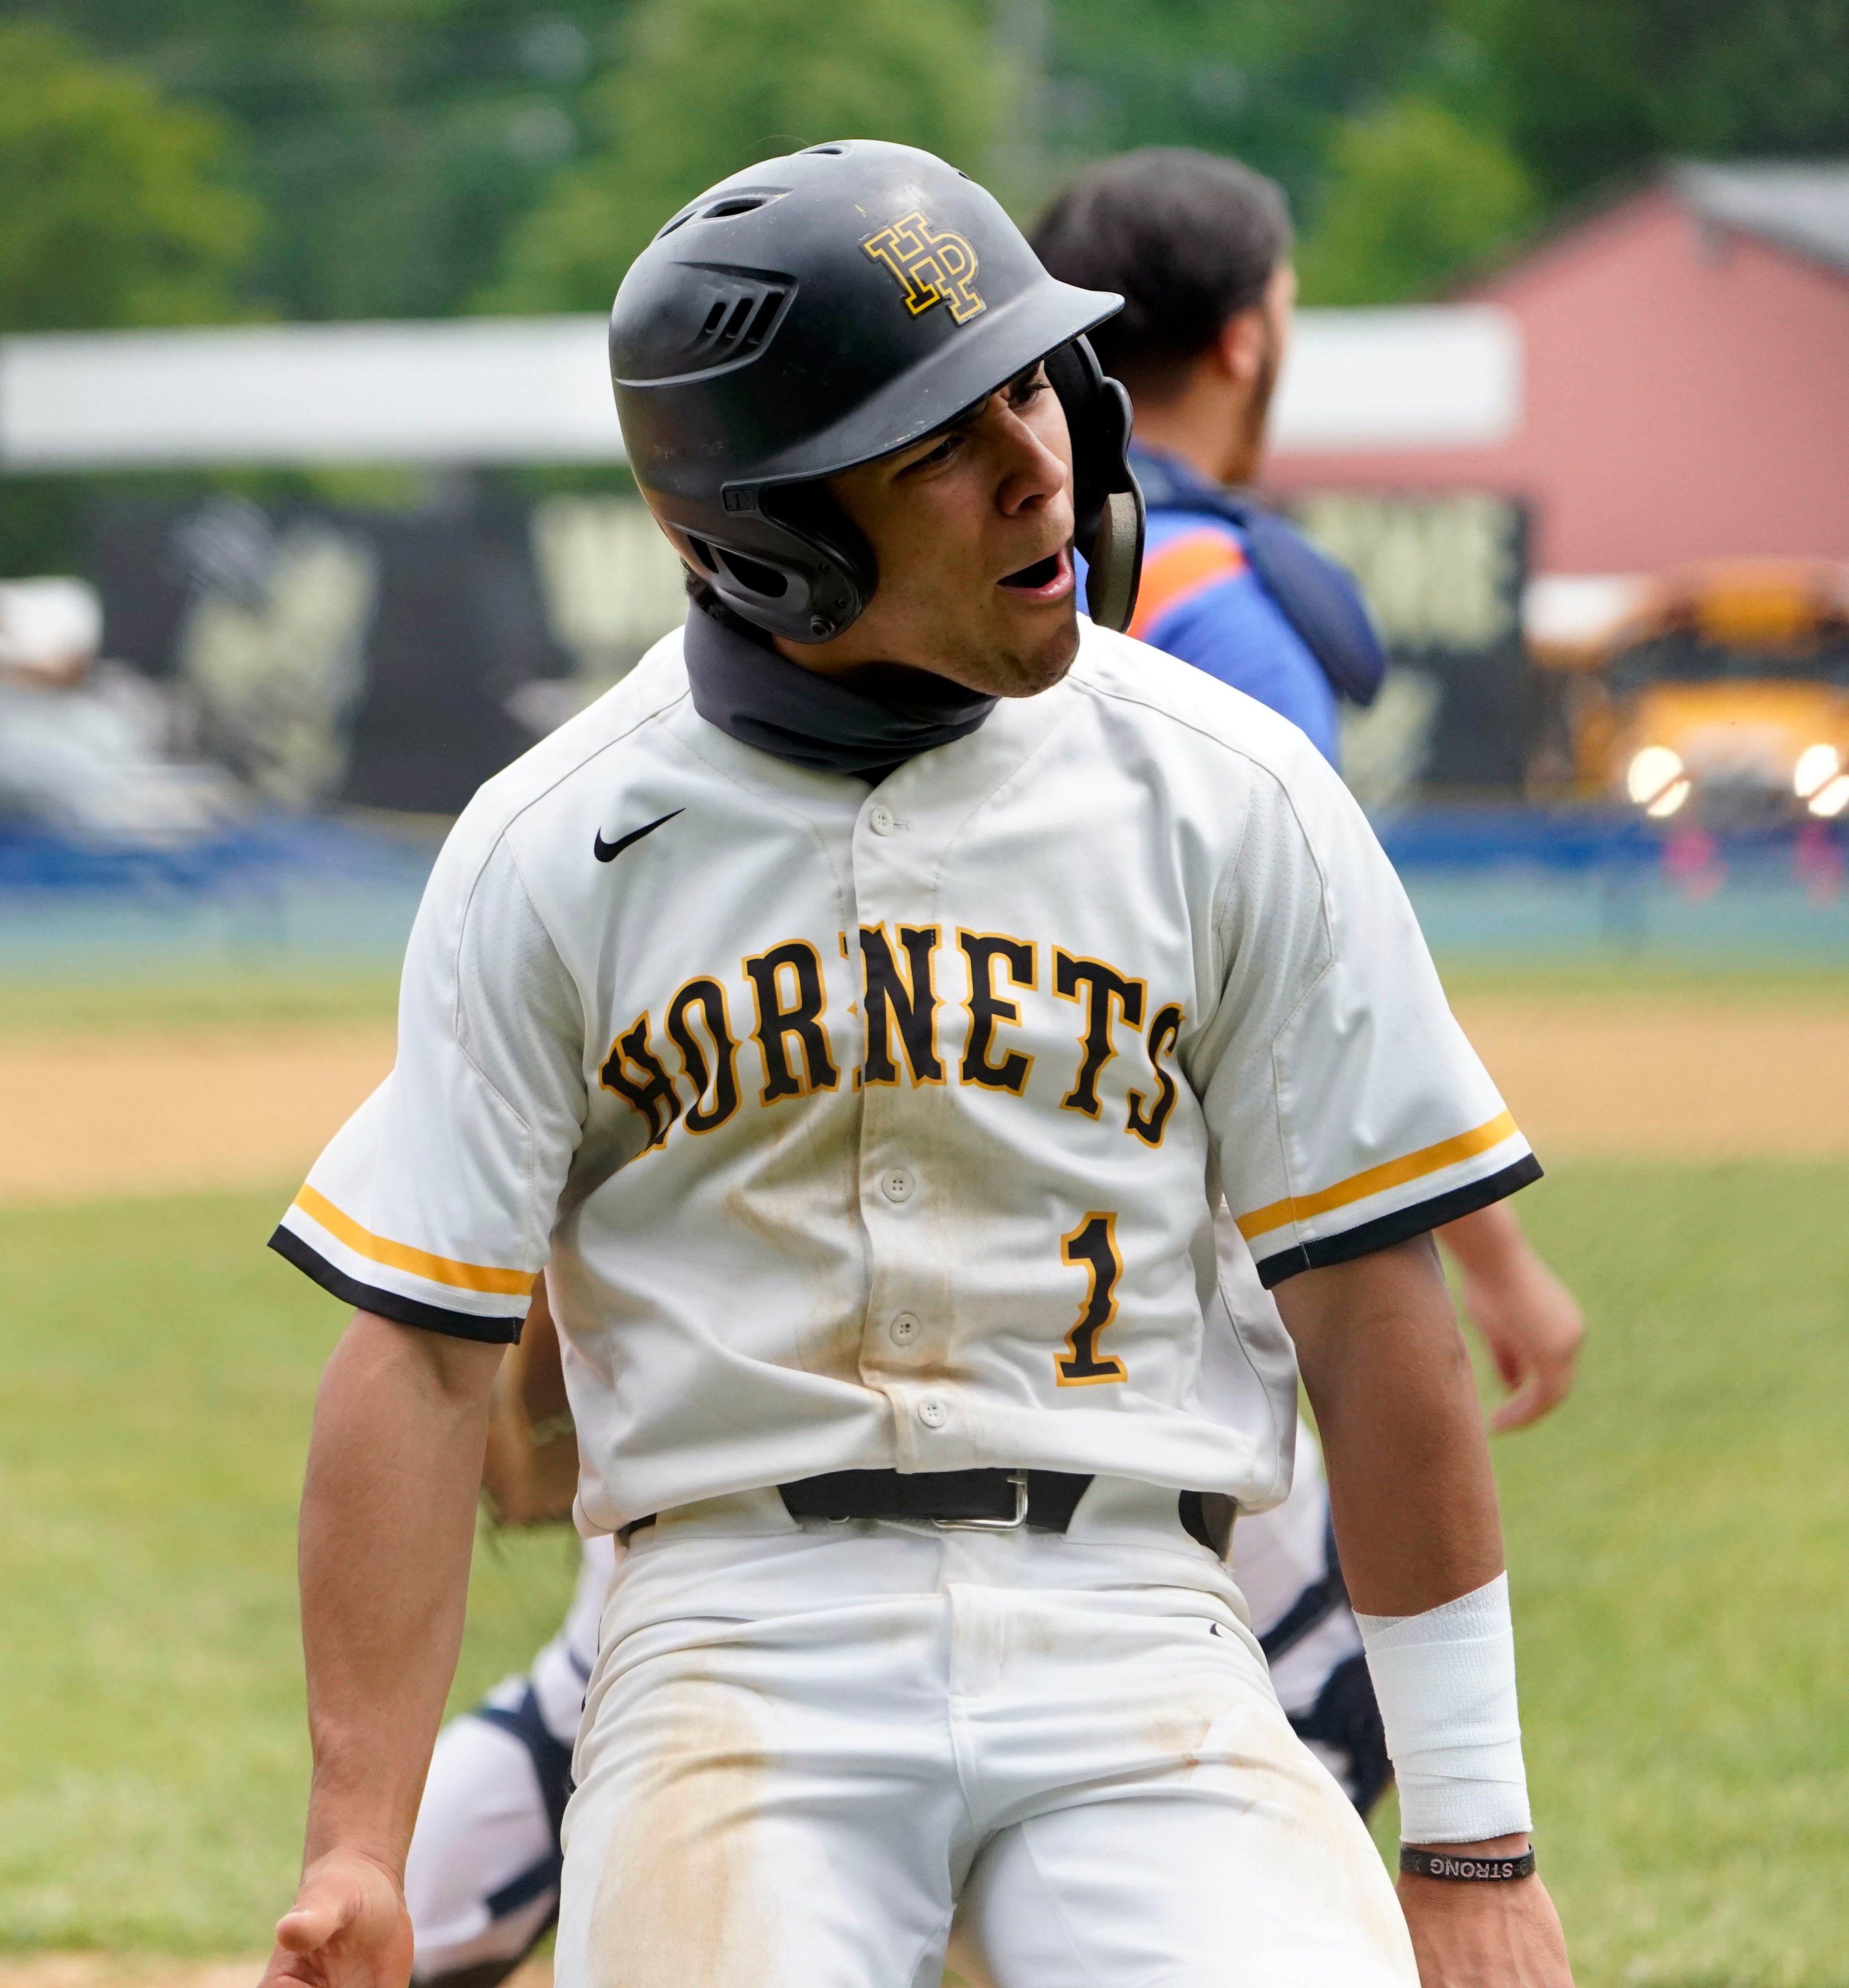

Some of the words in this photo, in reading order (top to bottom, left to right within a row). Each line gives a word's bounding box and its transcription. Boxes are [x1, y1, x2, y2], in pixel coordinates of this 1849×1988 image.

[864, 212, 983, 322] HP
[598, 920, 1186, 1161] HORNETS
[1053, 1211, 1128, 1387] 1
[1430, 1858, 1513, 1878] STRONG
